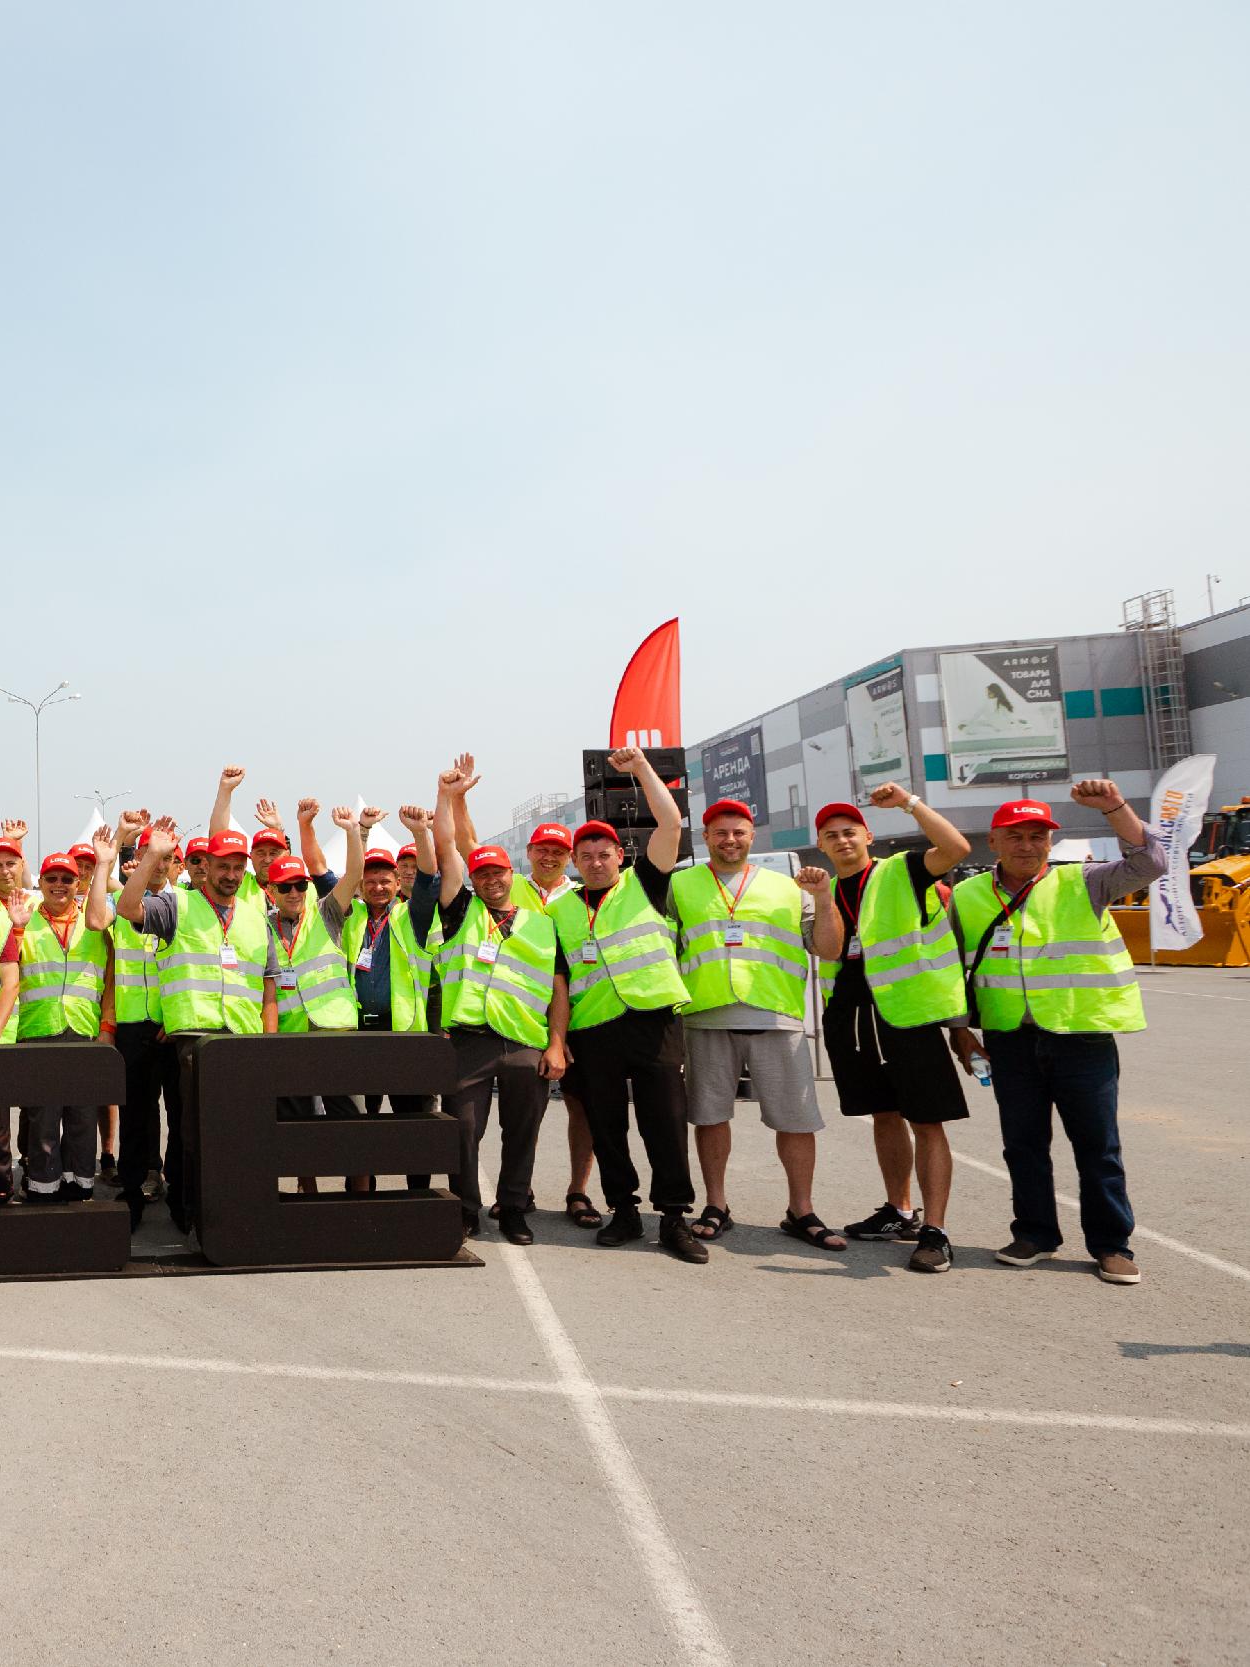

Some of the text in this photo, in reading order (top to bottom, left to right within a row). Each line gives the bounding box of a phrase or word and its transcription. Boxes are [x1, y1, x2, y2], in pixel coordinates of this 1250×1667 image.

[1011, 669, 1051, 679] ТОВАРЫ
[1026, 689, 1051, 699] СНА
[713, 756, 751, 781] АРЕНДА
[1013, 807, 1044, 816] LGCE
[543, 829, 566, 838] LGCE
